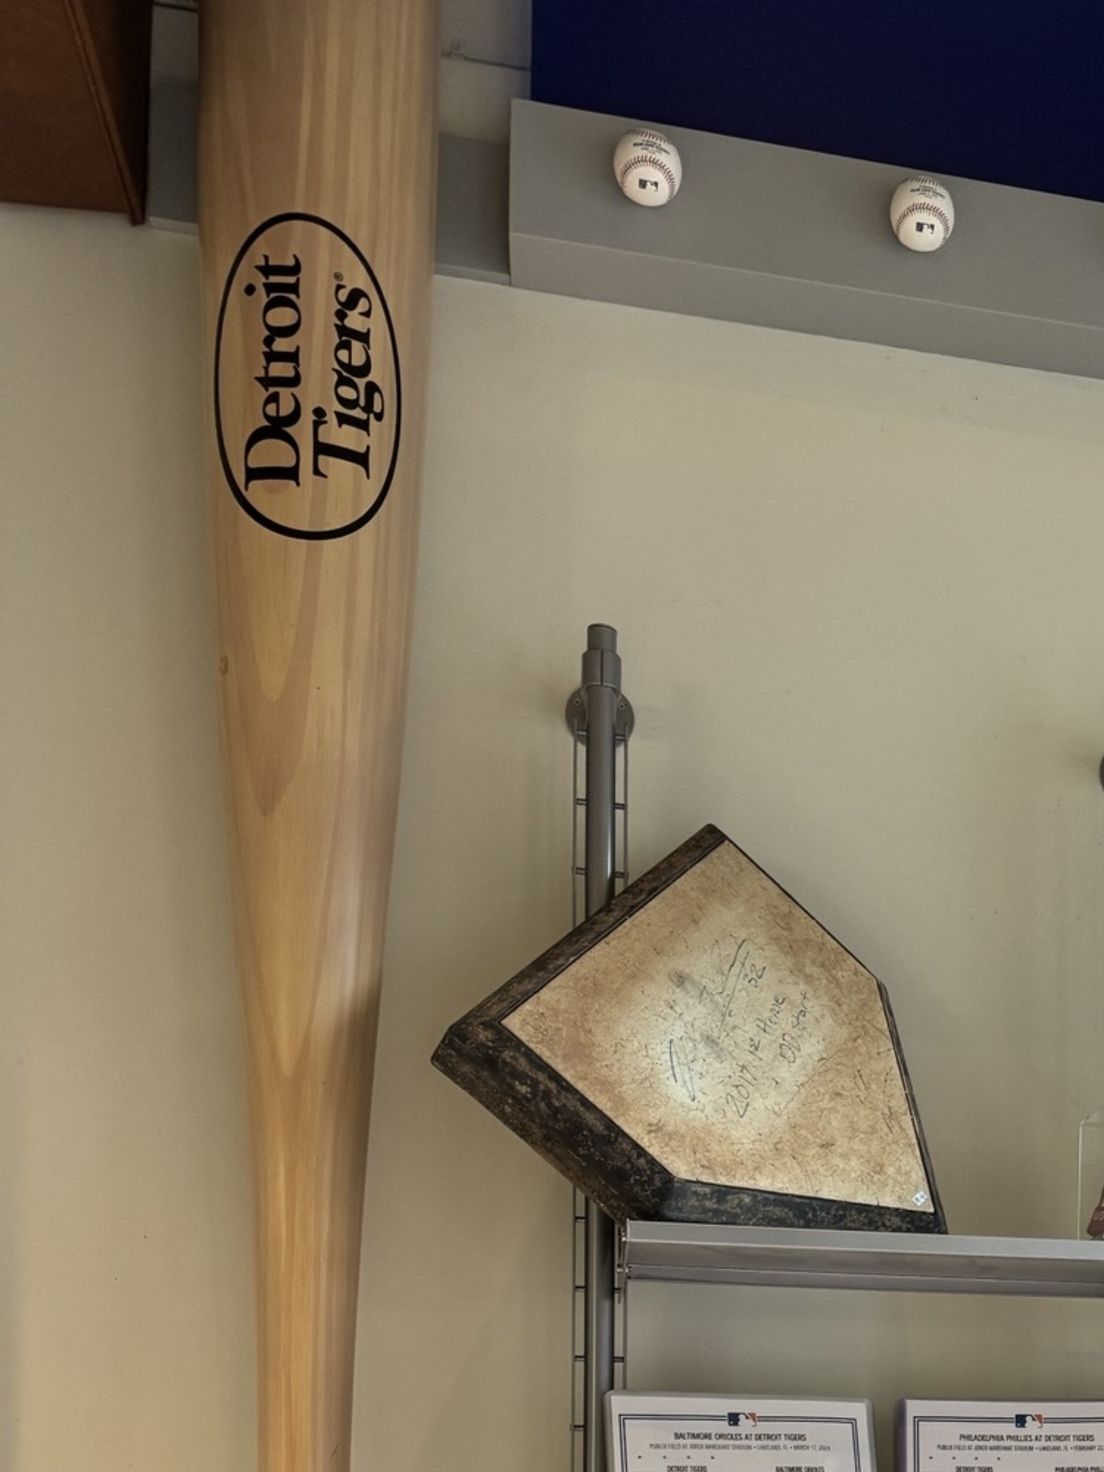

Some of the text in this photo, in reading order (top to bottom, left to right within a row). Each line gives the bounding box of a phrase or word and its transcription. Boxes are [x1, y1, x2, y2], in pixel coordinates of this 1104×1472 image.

[244, 254, 302, 491] Detroit
[312, 283, 385, 480] Tigers
[725, 1063, 758, 1119] 2017
[674, 1432, 713, 1441] BALTIMORE
[714, 1433, 742, 1441] ORIOLES
[744, 1433, 753, 1441] AT
[784, 1434, 806, 1442] TIGERS
[959, 1434, 1095, 1442] PHILADELPHIA PHILLIES AT DETROIT TIGERS
